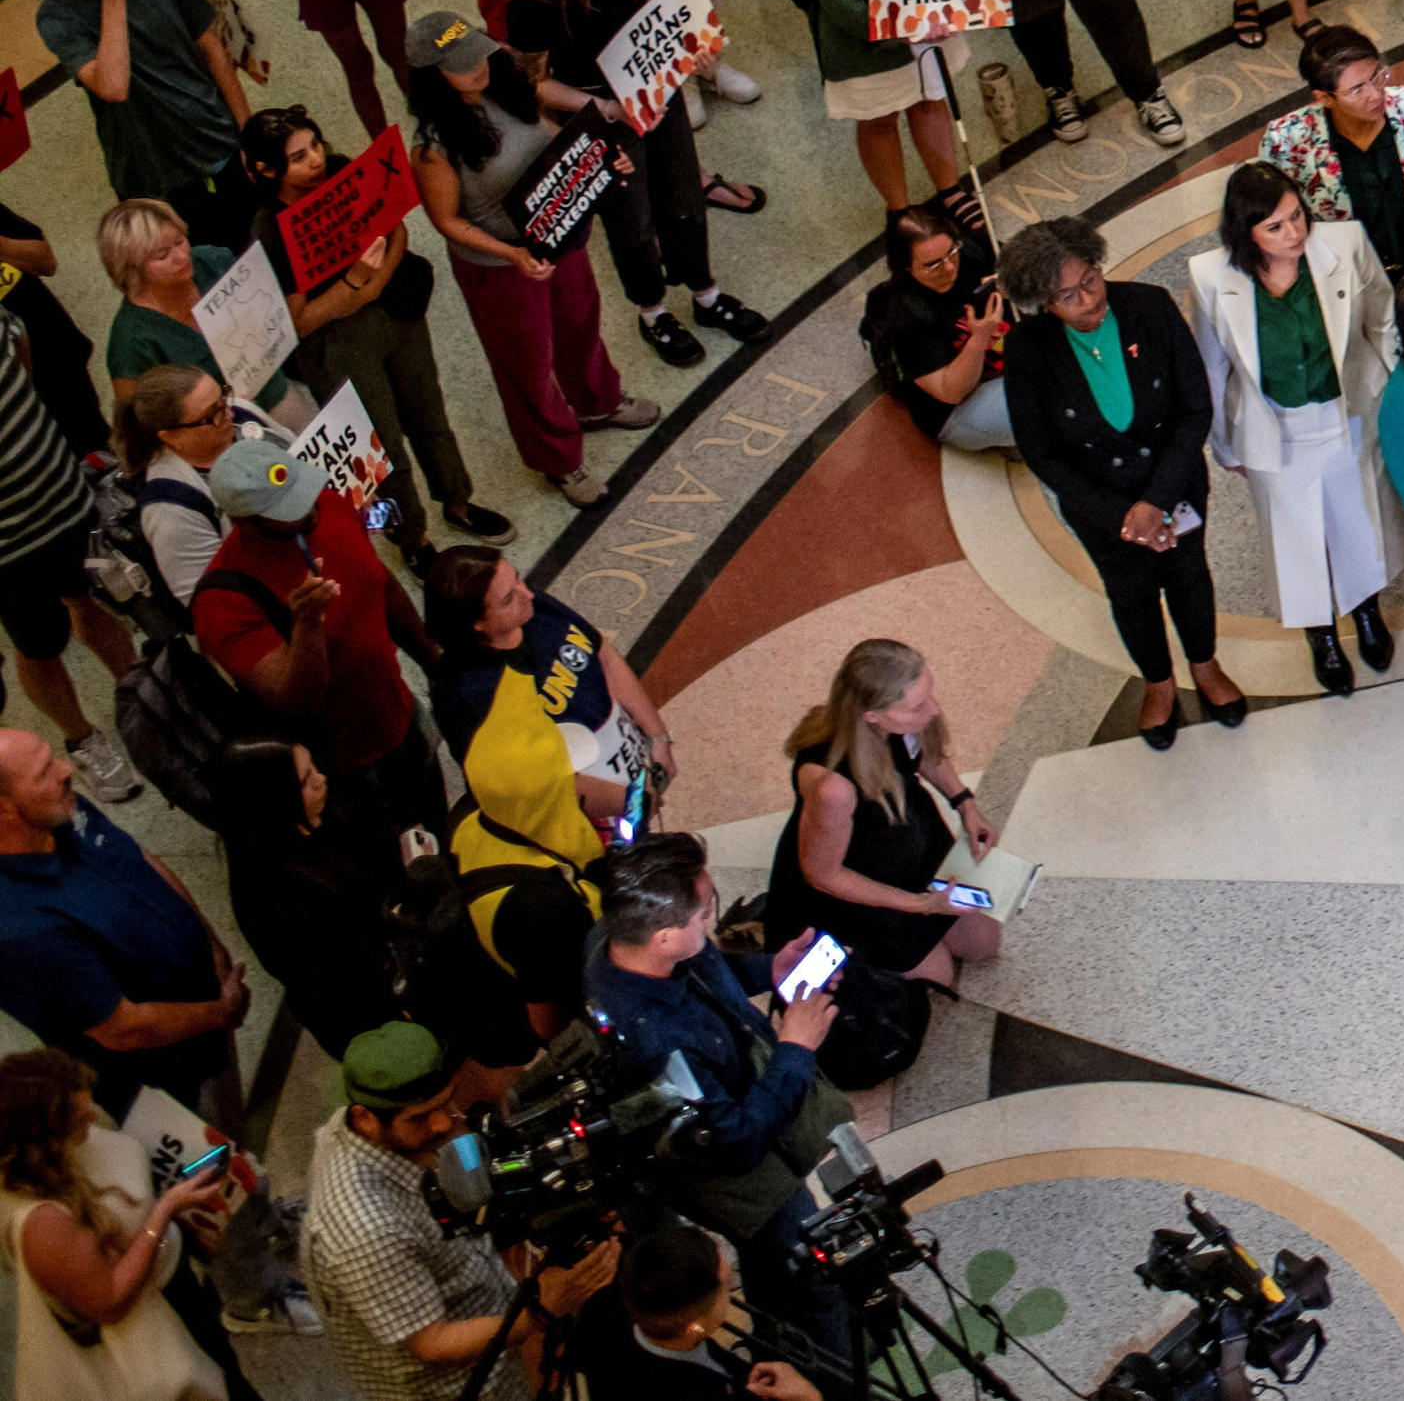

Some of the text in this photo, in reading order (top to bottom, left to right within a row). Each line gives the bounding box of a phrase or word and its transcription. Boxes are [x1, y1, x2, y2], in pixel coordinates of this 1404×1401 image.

[622, 7, 691, 78] TEXANS
[628, 5, 663, 47] PUT
[640, 31, 686, 86] FIRST
[525, 132, 591, 212] FIGHT THE
[525, 139, 607, 243] TRUMP
[545, 170, 611, 247] TAKEOVER
